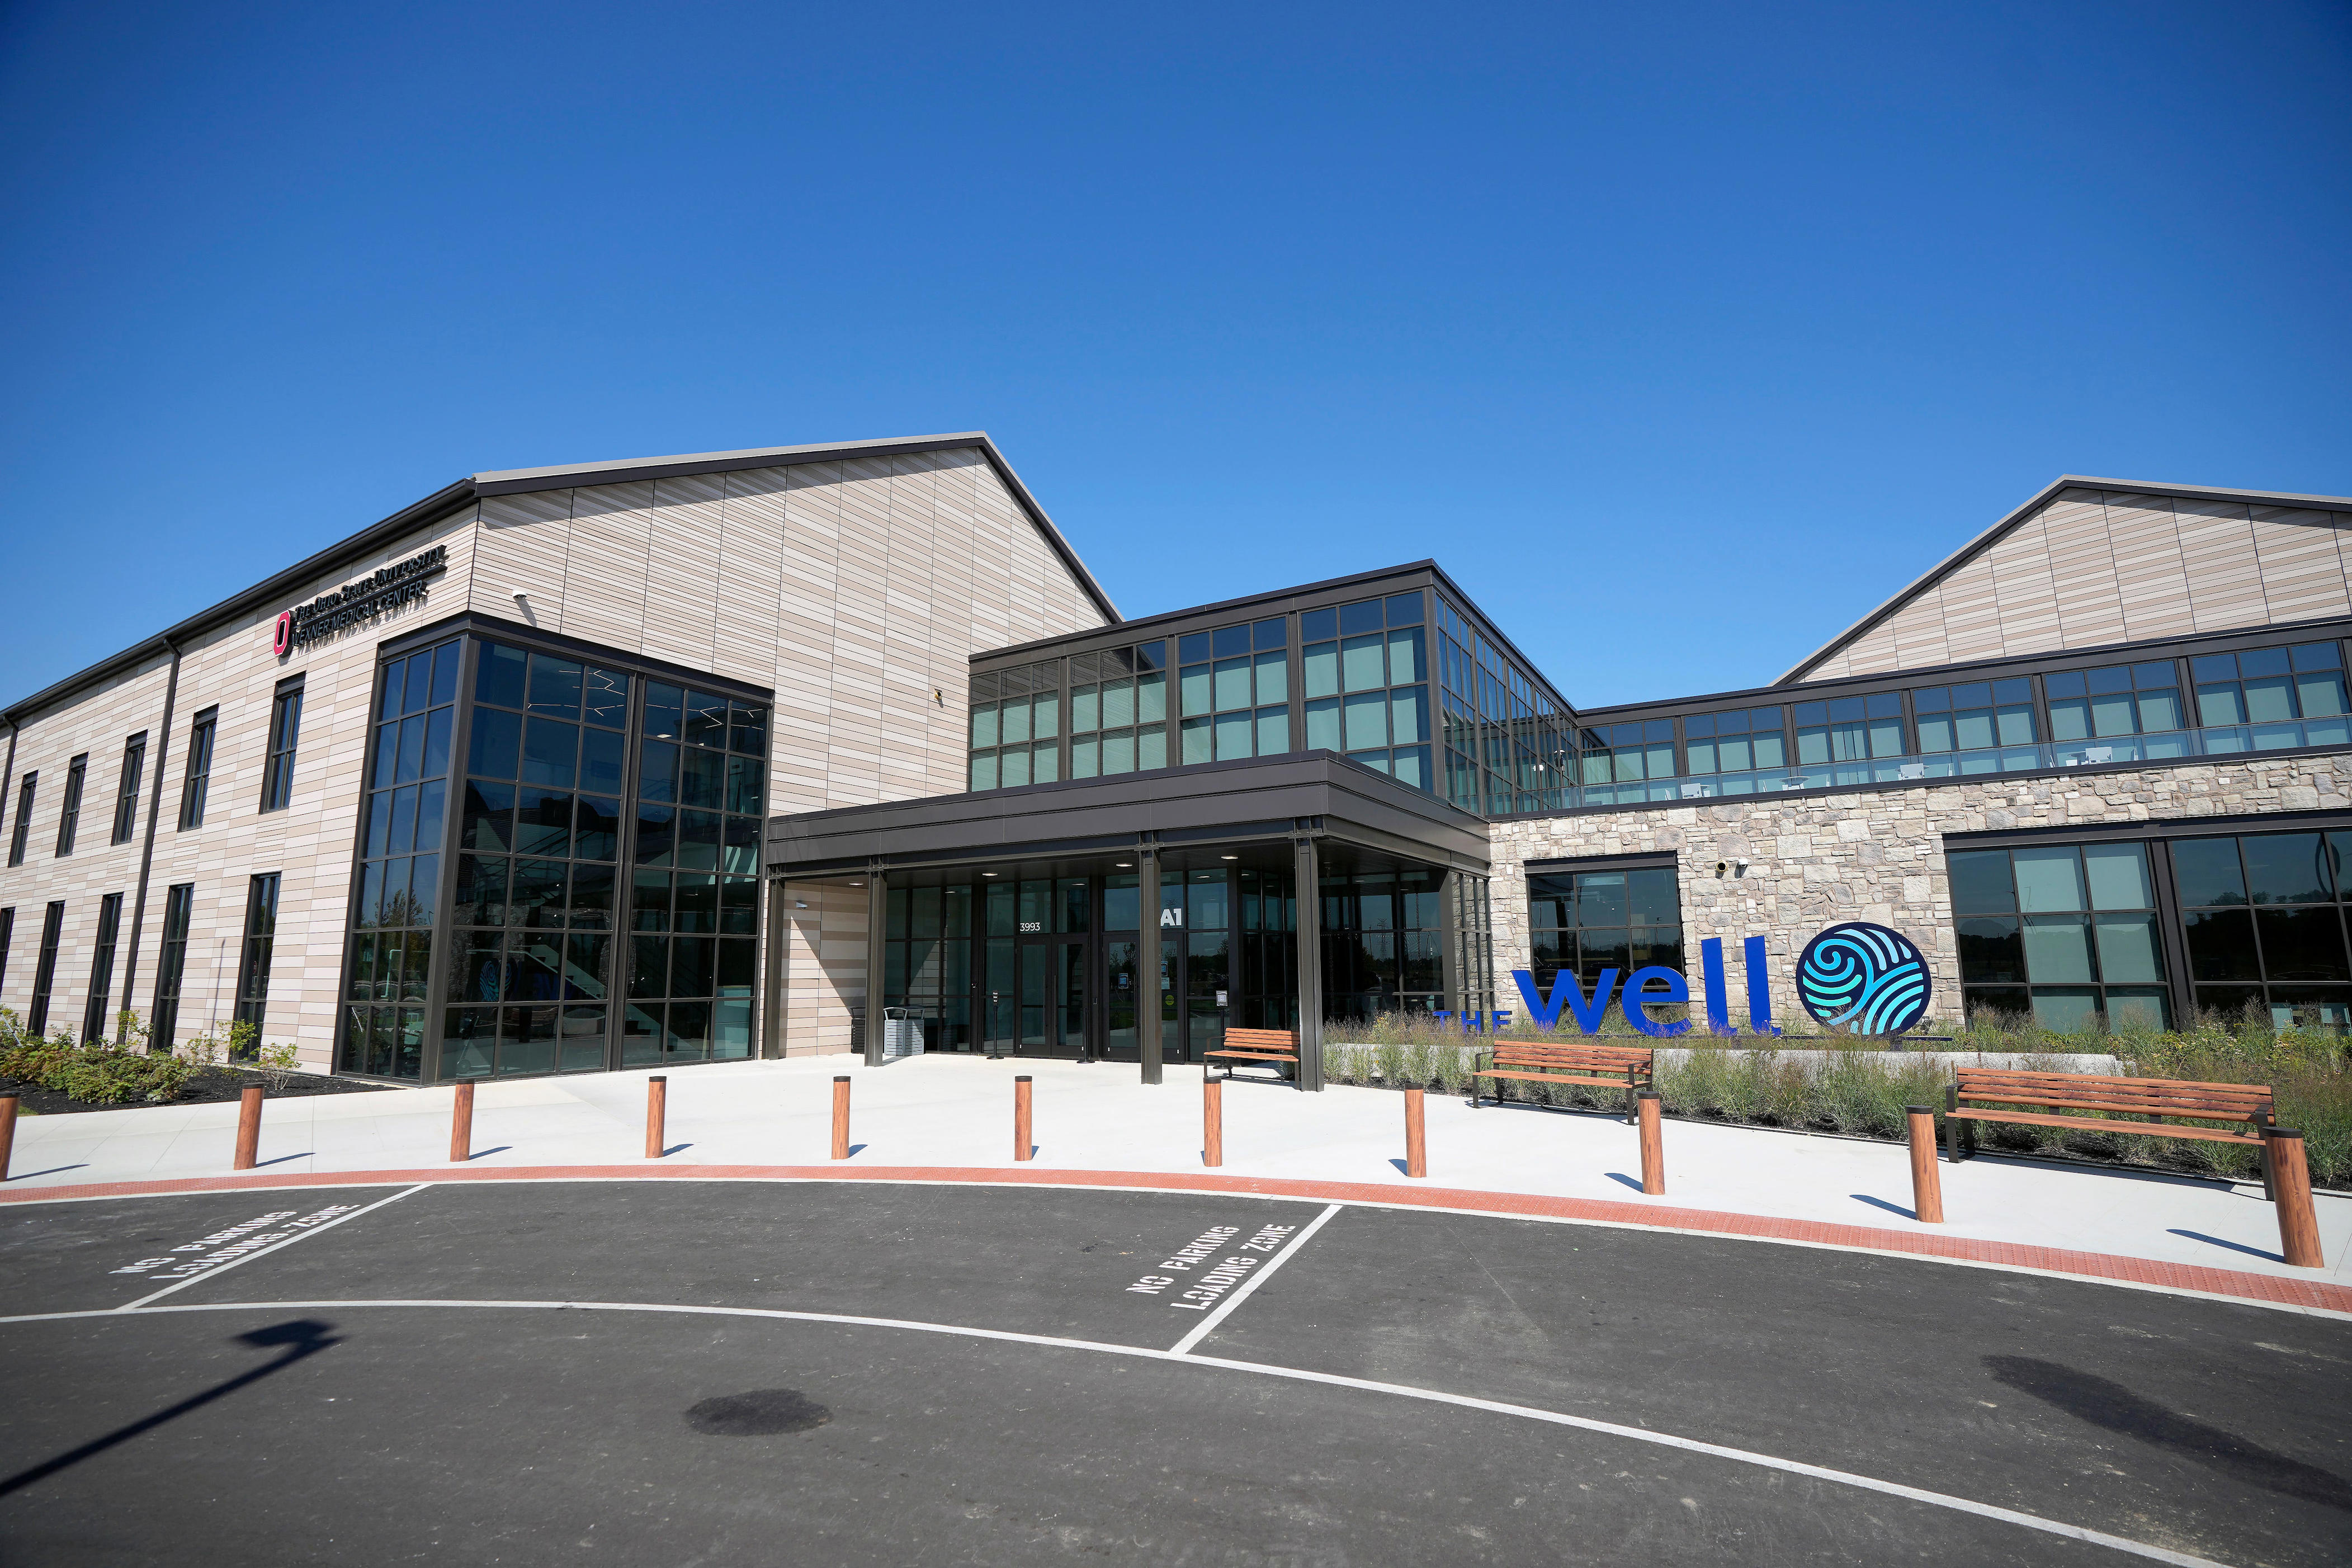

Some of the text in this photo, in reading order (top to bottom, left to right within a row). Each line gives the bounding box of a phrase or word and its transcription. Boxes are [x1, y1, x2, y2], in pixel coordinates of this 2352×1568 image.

[292, 580, 427, 647] WEXNER MEDICAL CENTER
[295, 545, 447, 621] THE OHIO STATE UNIVERSITY
[1020, 922, 1041, 932] 3993
[1160, 908, 1182, 926] A1
[1433, 935, 1782, 1038] THE well
[108, 1211, 297, 1274] NO PARKING
[148, 1204, 361, 1279] LOADING ZONE
[1125, 1226, 1240, 1295] NO PARKING
[1170, 1224, 1297, 1310] LOADING ZONE
